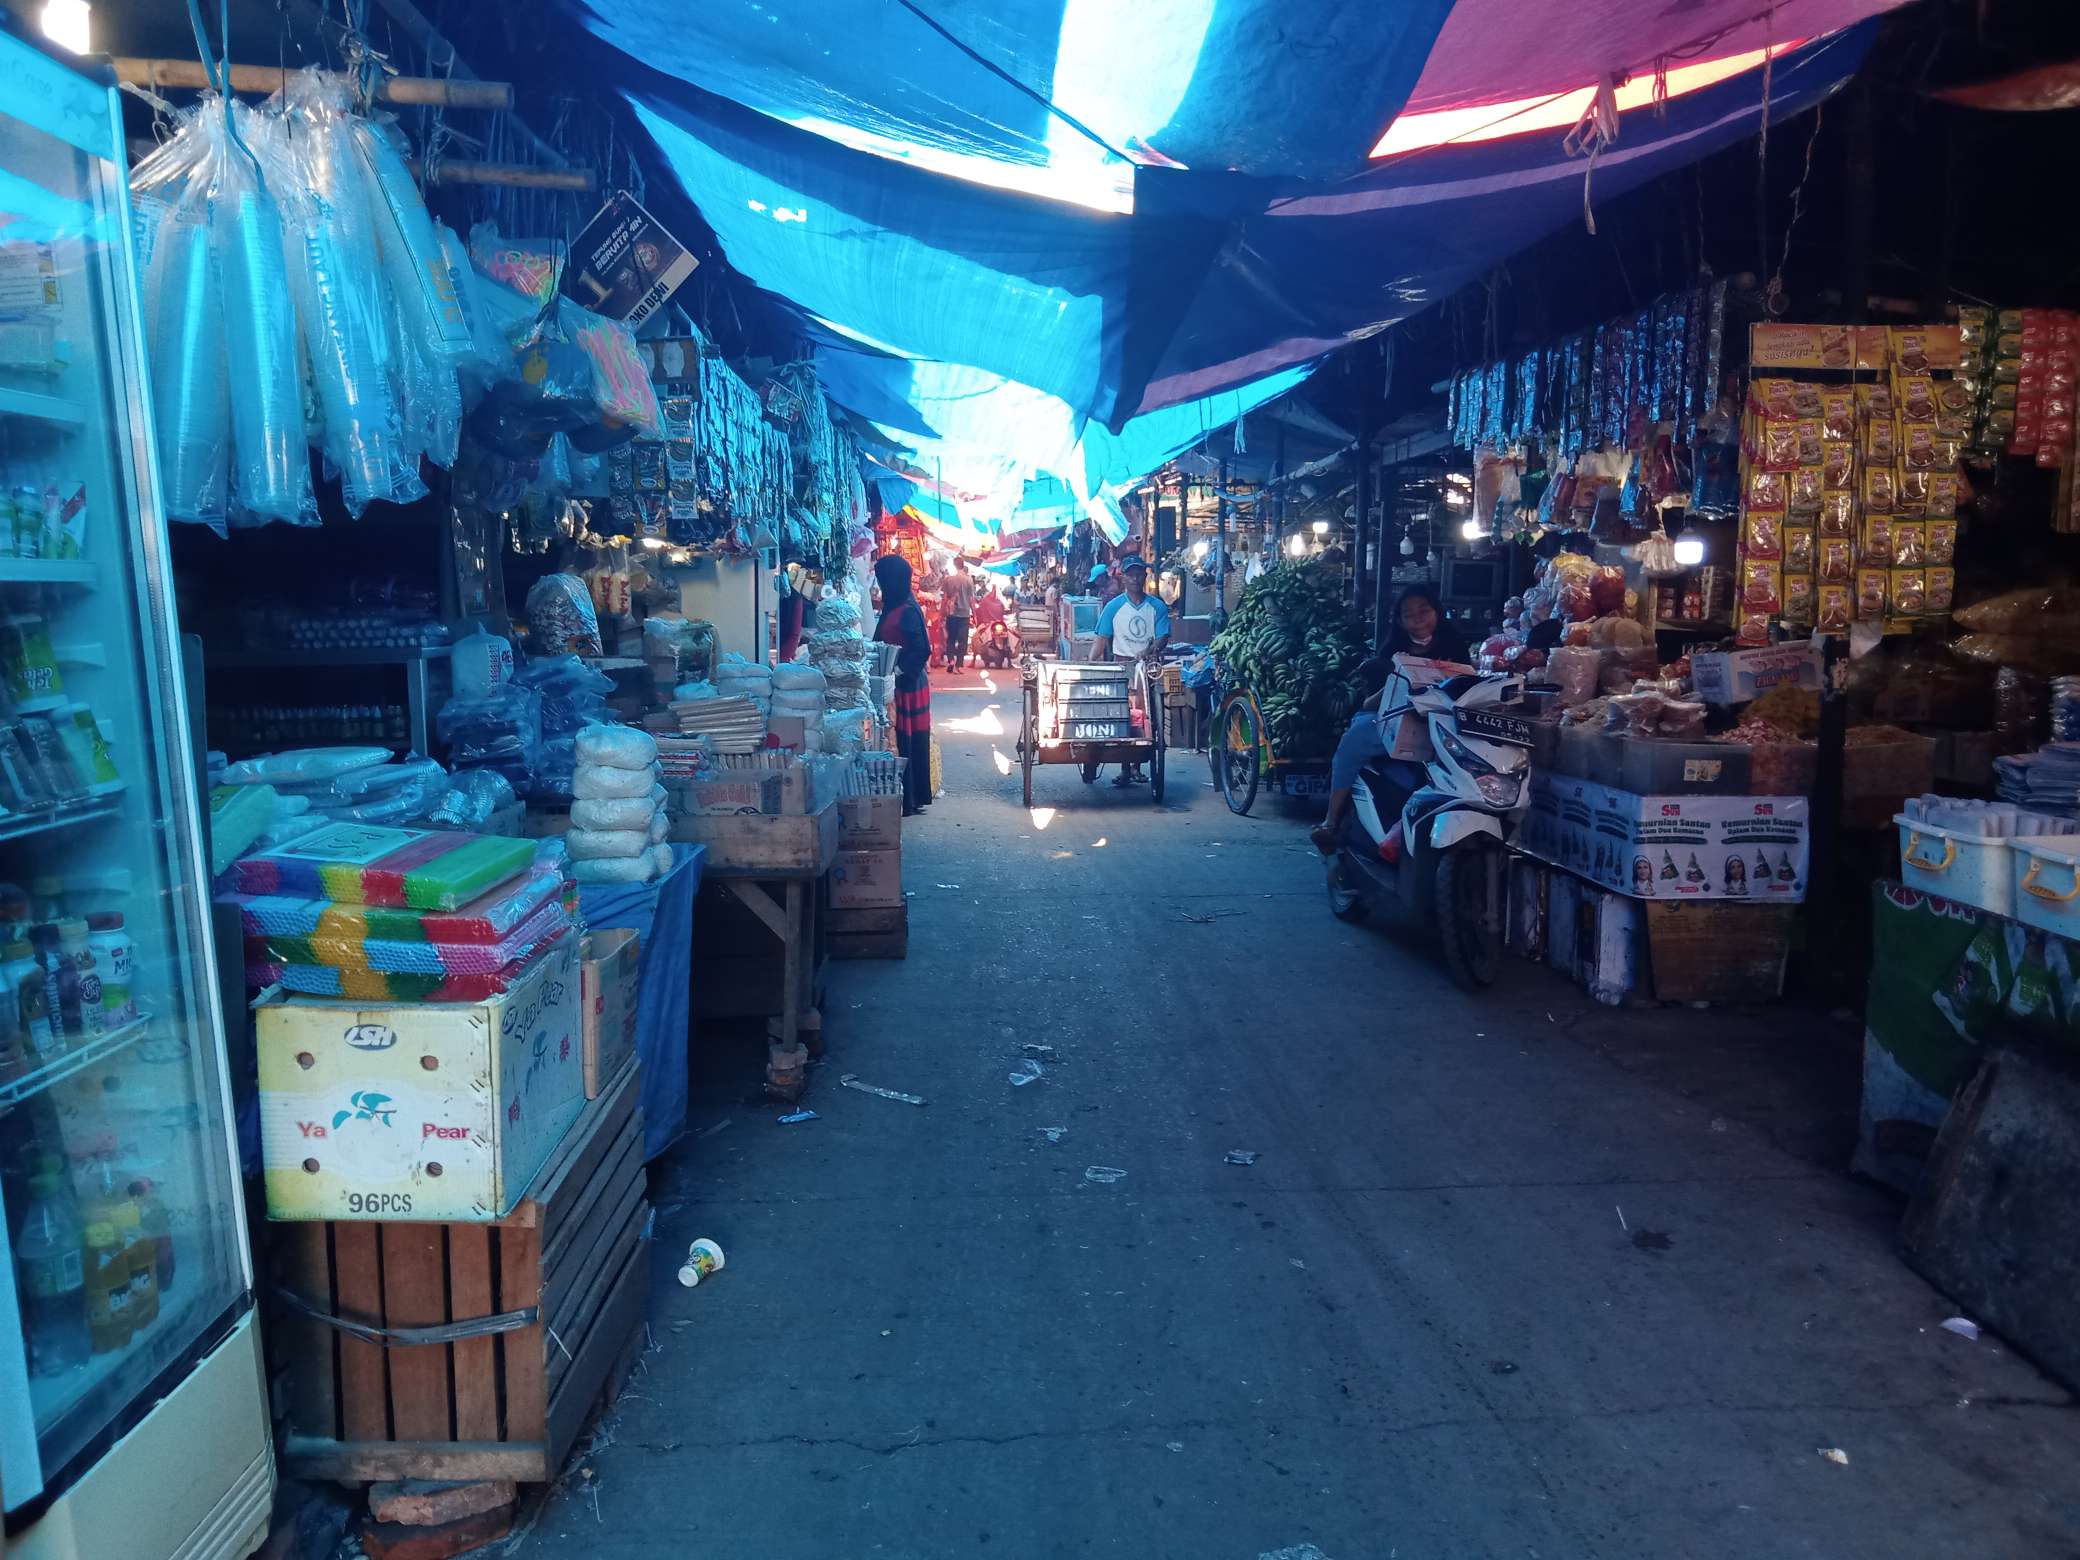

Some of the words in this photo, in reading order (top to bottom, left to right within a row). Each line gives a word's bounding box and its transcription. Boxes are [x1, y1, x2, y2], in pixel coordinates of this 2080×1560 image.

[1074, 723, 1116, 739] JONI
[345, 1024, 396, 1048] LSH
[297, 1121, 328, 1139] Ya
[421, 1123, 471, 1140] Pear
